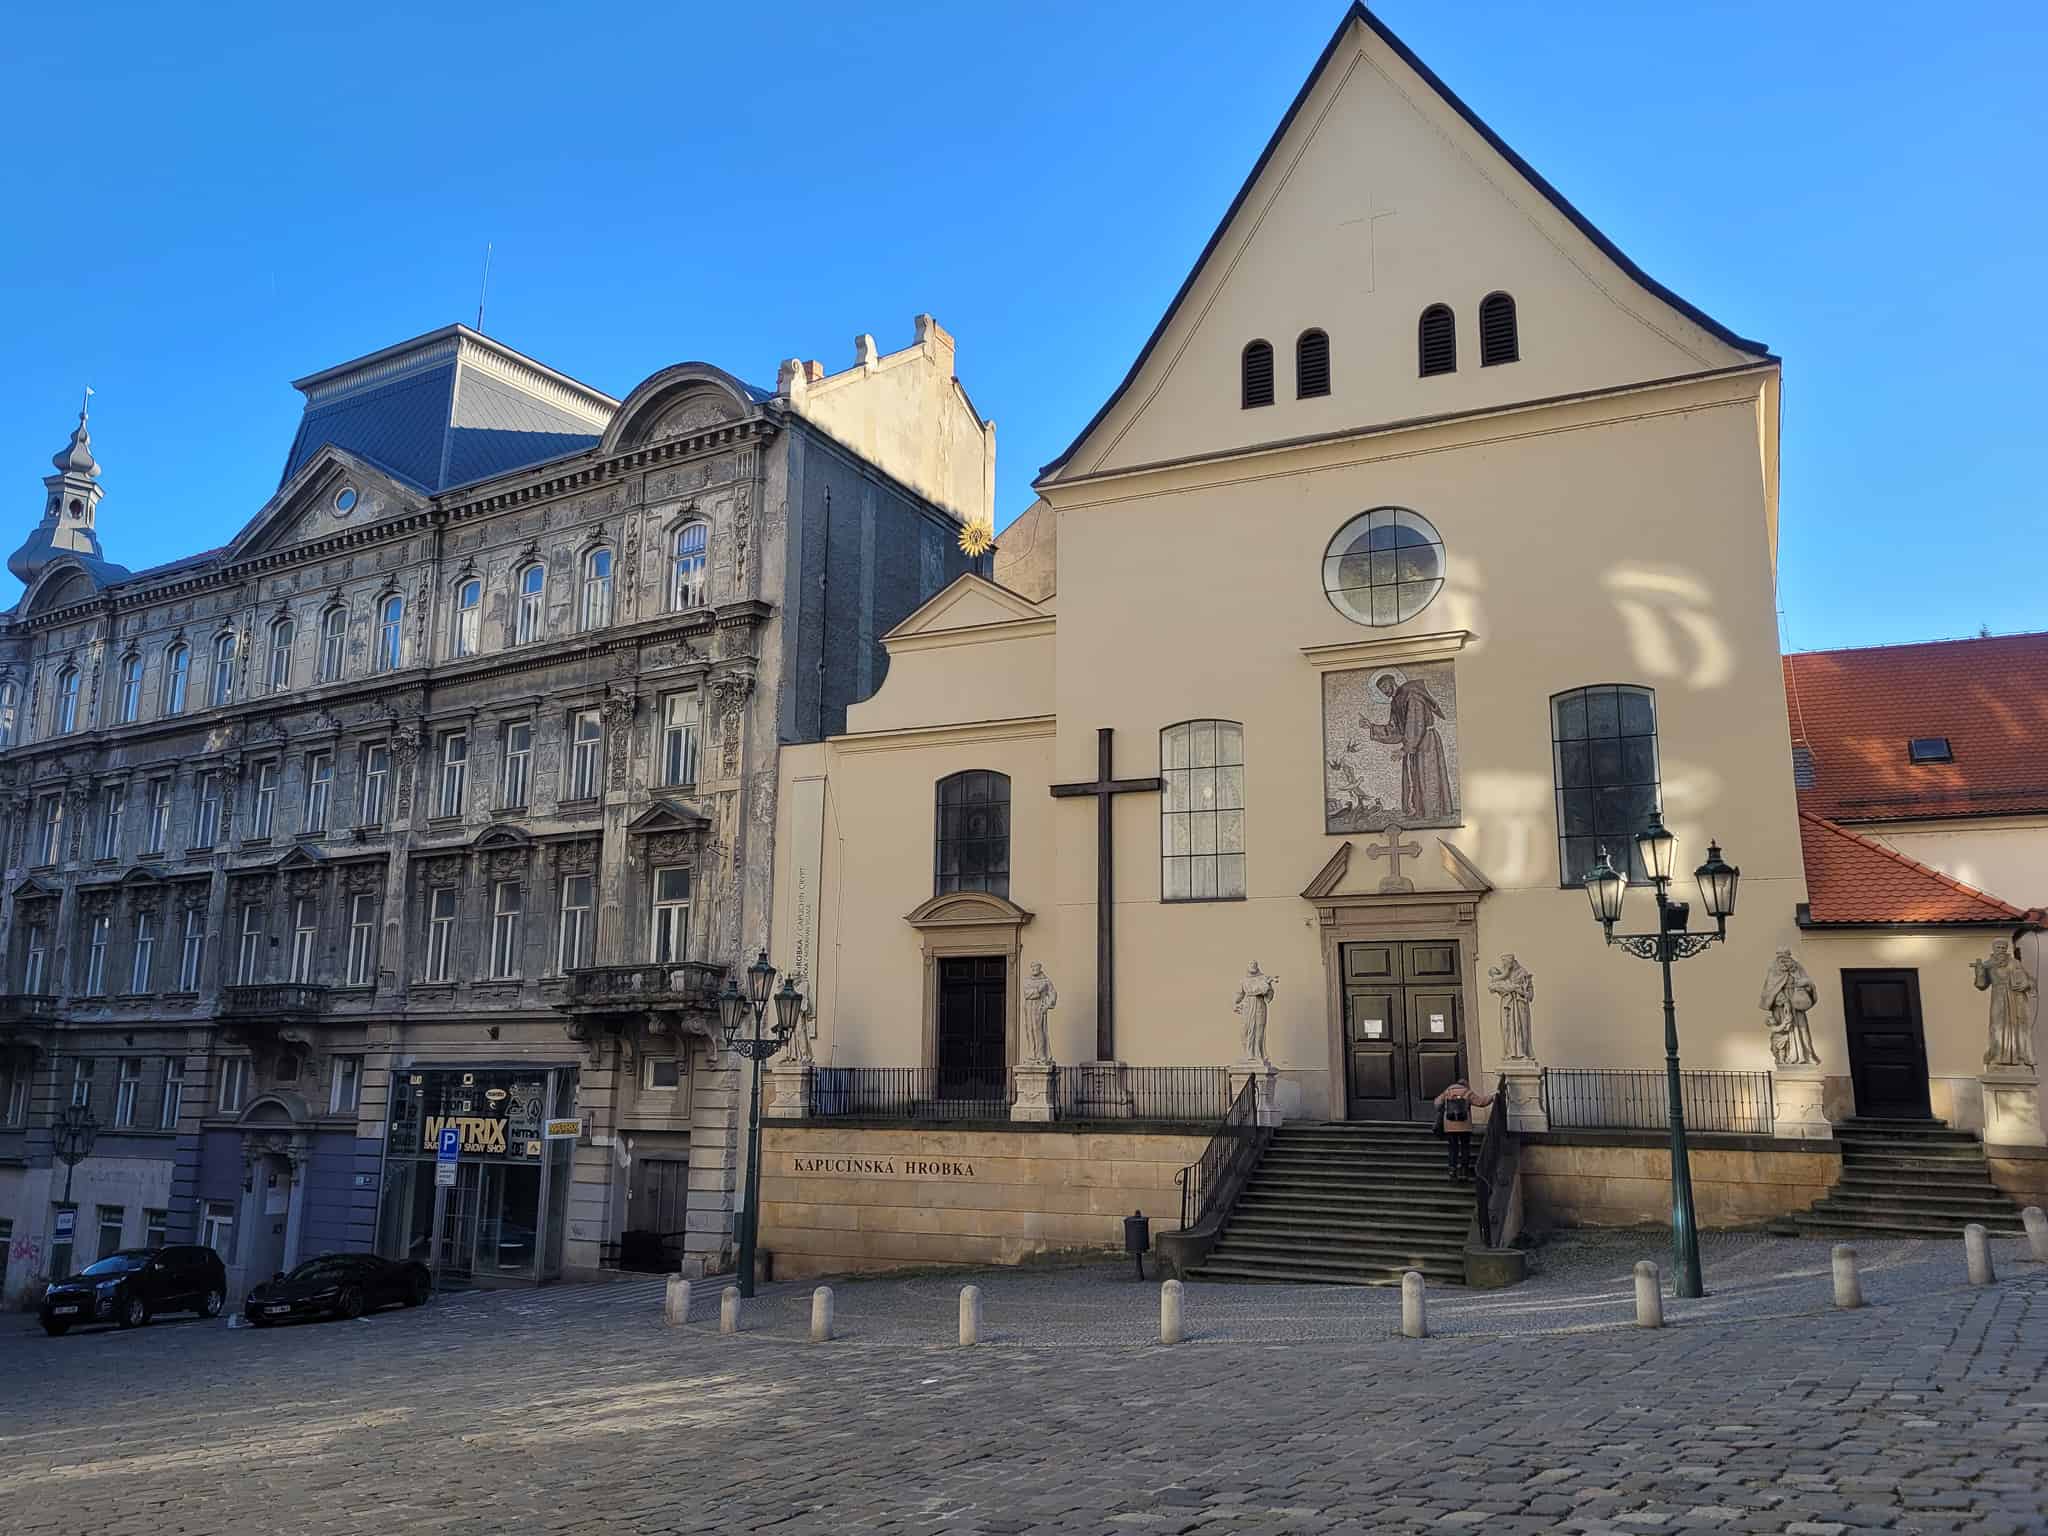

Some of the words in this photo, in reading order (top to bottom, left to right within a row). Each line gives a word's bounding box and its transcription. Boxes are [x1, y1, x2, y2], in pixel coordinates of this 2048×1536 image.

[443, 1132, 456, 1151] P
[464, 1142, 485, 1152] SNOW
[487, 1144, 506, 1153] SHOP
[795, 1156, 895, 1174] KAPUCÍNSKÁ
[905, 1161, 975, 1177] HROBKA
